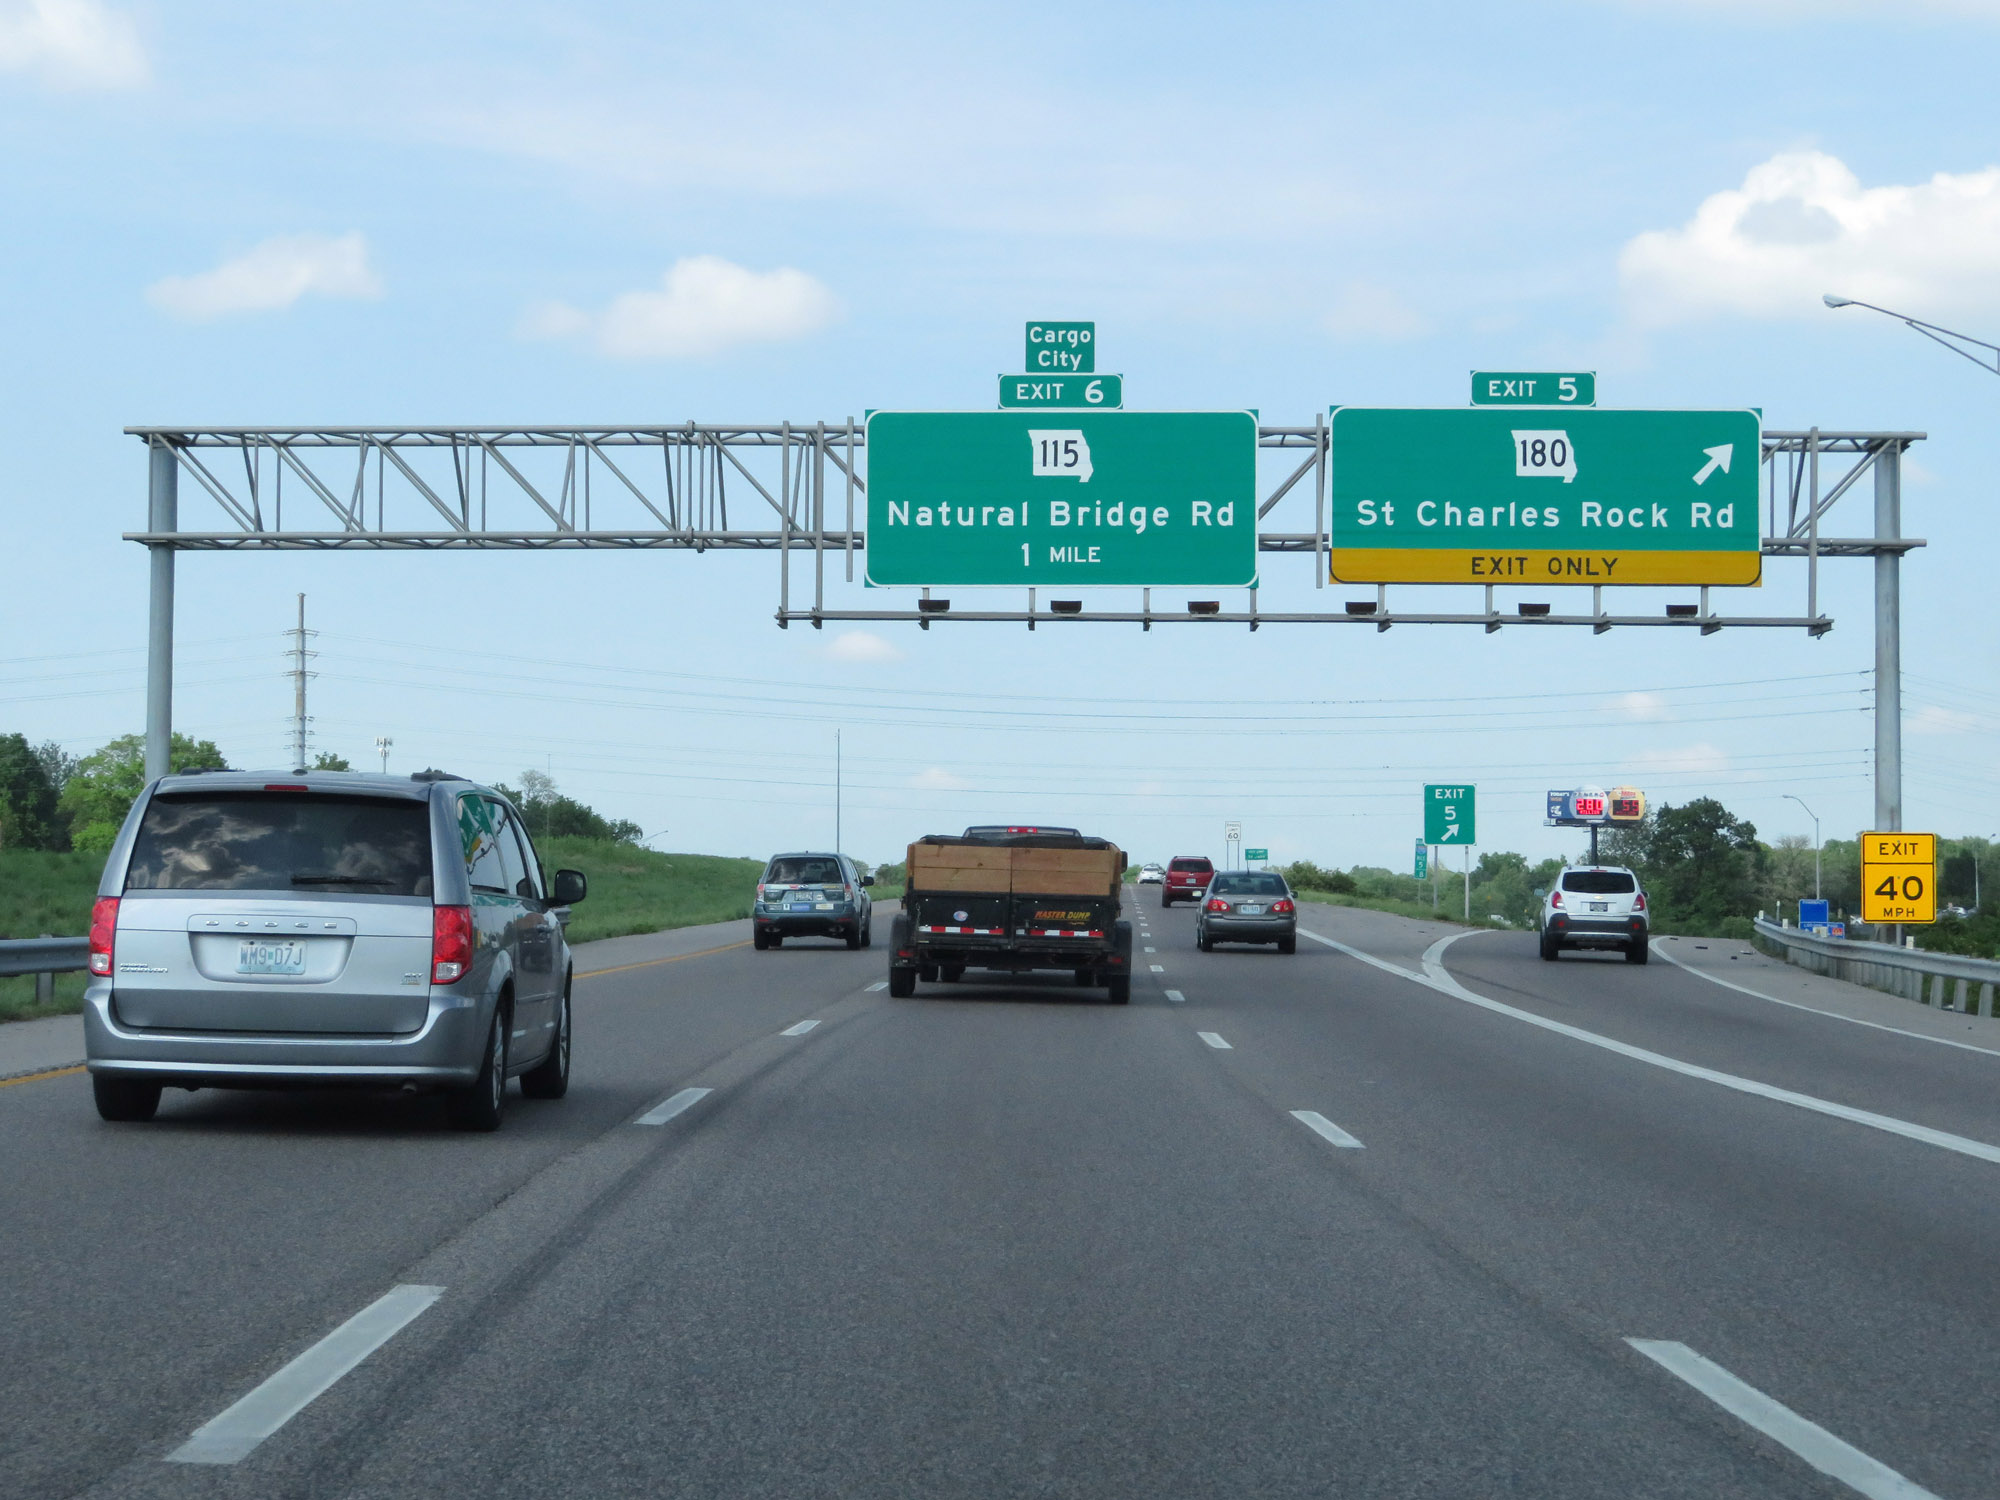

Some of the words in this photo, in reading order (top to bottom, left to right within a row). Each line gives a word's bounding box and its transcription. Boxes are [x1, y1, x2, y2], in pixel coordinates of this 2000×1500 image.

[1029, 326, 1092, 348] Cargo
[1038, 350, 1082, 370] City
[1016, 383, 1064, 400] EXIT
[1084, 380, 1104, 404] 6
[1489, 380, 1537, 397] EXIT
[1558, 377, 1578, 401] 5
[1041, 439, 1079, 468] 115
[1520, 438, 1567, 467] 180
[888, 500, 1029, 527] Natural
[1050, 500, 1169, 535] Bridge
[1191, 500, 1234, 527] Rd
[1357, 500, 1395, 527] St
[1417, 500, 1560, 528] Charles
[1581, 501, 1668, 528] Rock
[1691, 502, 1734, 529] Rd
[1021, 543, 1030, 567] 1
[1050, 546, 1101, 563] MILE
[1471, 557, 1526, 576] EXIT
[1548, 557, 1618, 576] ONLY
[1435, 788, 1465, 799] EXIT
[1576, 798, 1604, 811] 280
[1444, 805, 1456, 820] 5
[1879, 842, 1918, 856] EXIT
[1874, 875, 1924, 901] 40
[1067, 911, 1091, 919] DUMP
[1883, 907, 1915, 918] MPH
